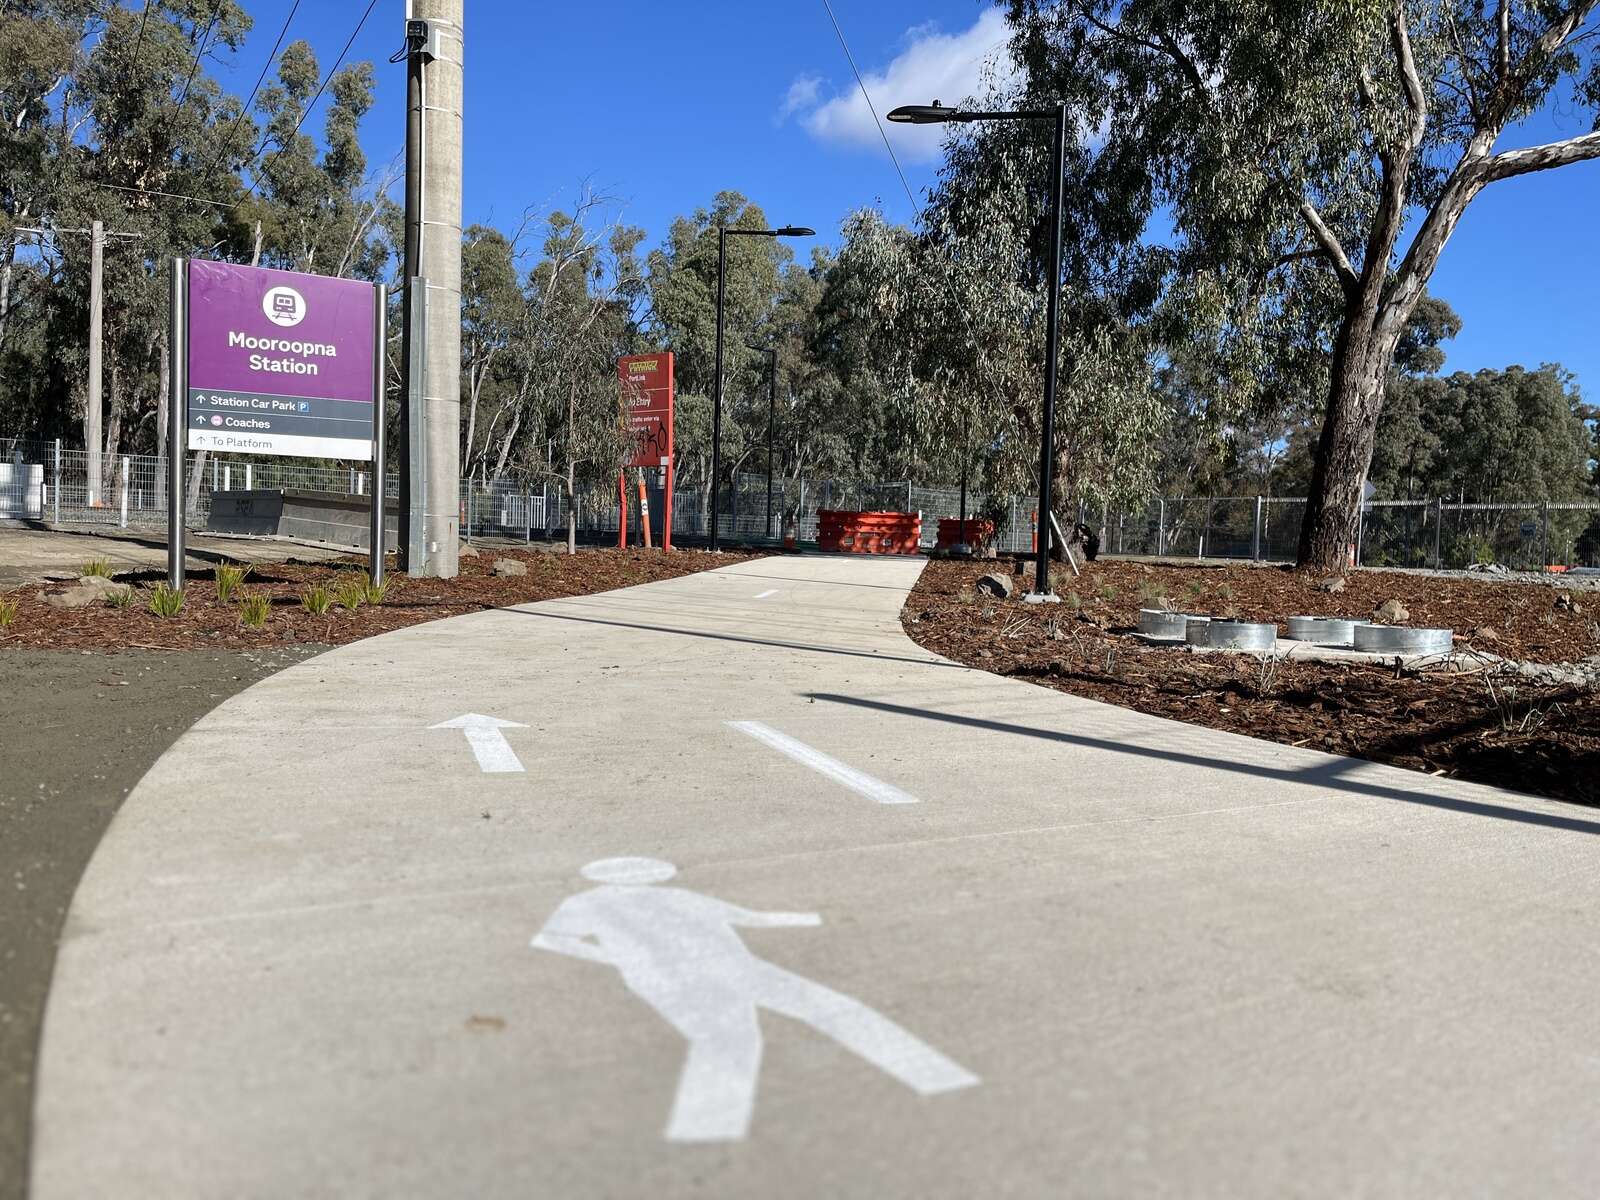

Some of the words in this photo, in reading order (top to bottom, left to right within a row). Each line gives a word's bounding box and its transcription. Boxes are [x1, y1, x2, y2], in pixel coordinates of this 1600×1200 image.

[228, 331, 337, 357] Mooroopna
[249, 355, 318, 375] Station
[210, 395, 249, 408] Station
[251, 399, 270, 409] Car
[272, 400, 296, 411] Park
[225, 417, 271, 429] Coaches
[211, 436, 225, 446] To
[227, 438, 273, 448] Platform
